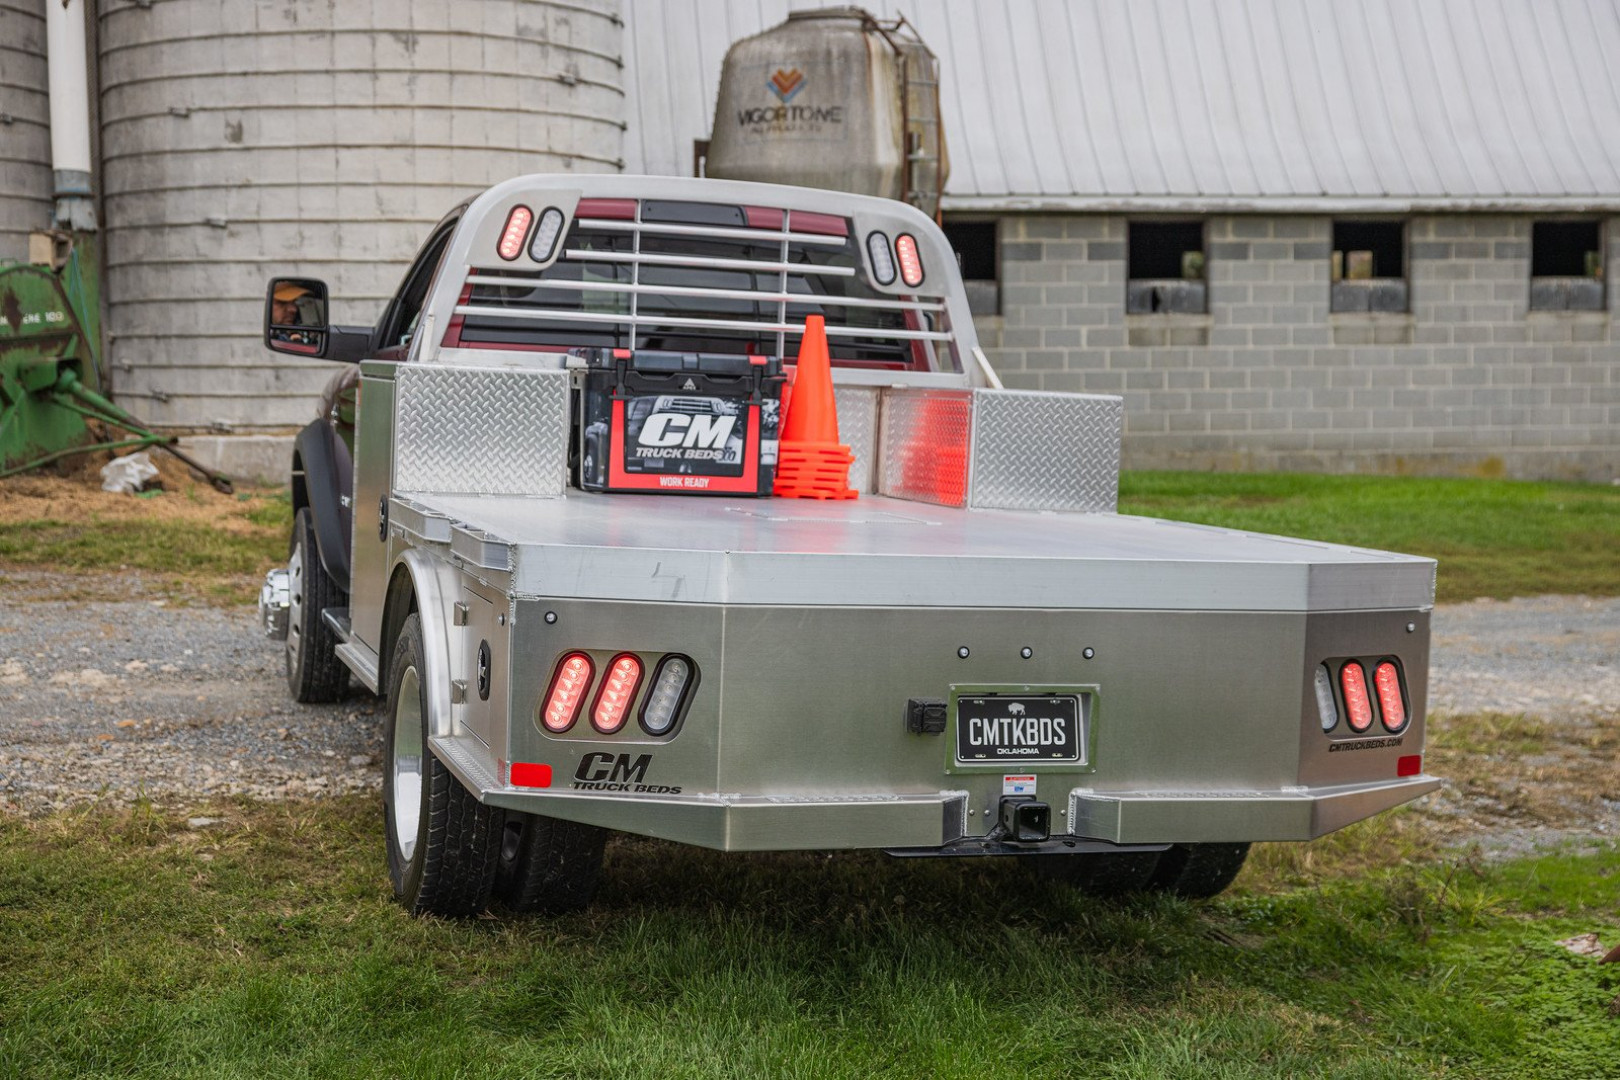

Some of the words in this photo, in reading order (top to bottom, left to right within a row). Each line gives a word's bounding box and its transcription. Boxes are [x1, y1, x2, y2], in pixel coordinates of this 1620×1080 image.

[638, 413, 737, 448] CM
[636, 447, 682, 459] TRUCK
[684, 449, 724, 460] BEDS
[660, 477, 683, 486] WORK
[684, 477, 709, 488] READY
[969, 718, 1066, 746] CMTKBDS
[1328, 738, 1403, 753] CMTRUCKBEDS.COM
[574, 752, 653, 783] CM
[573, 781, 629, 792] TRUCK
[634, 784, 682, 794] BEDS
